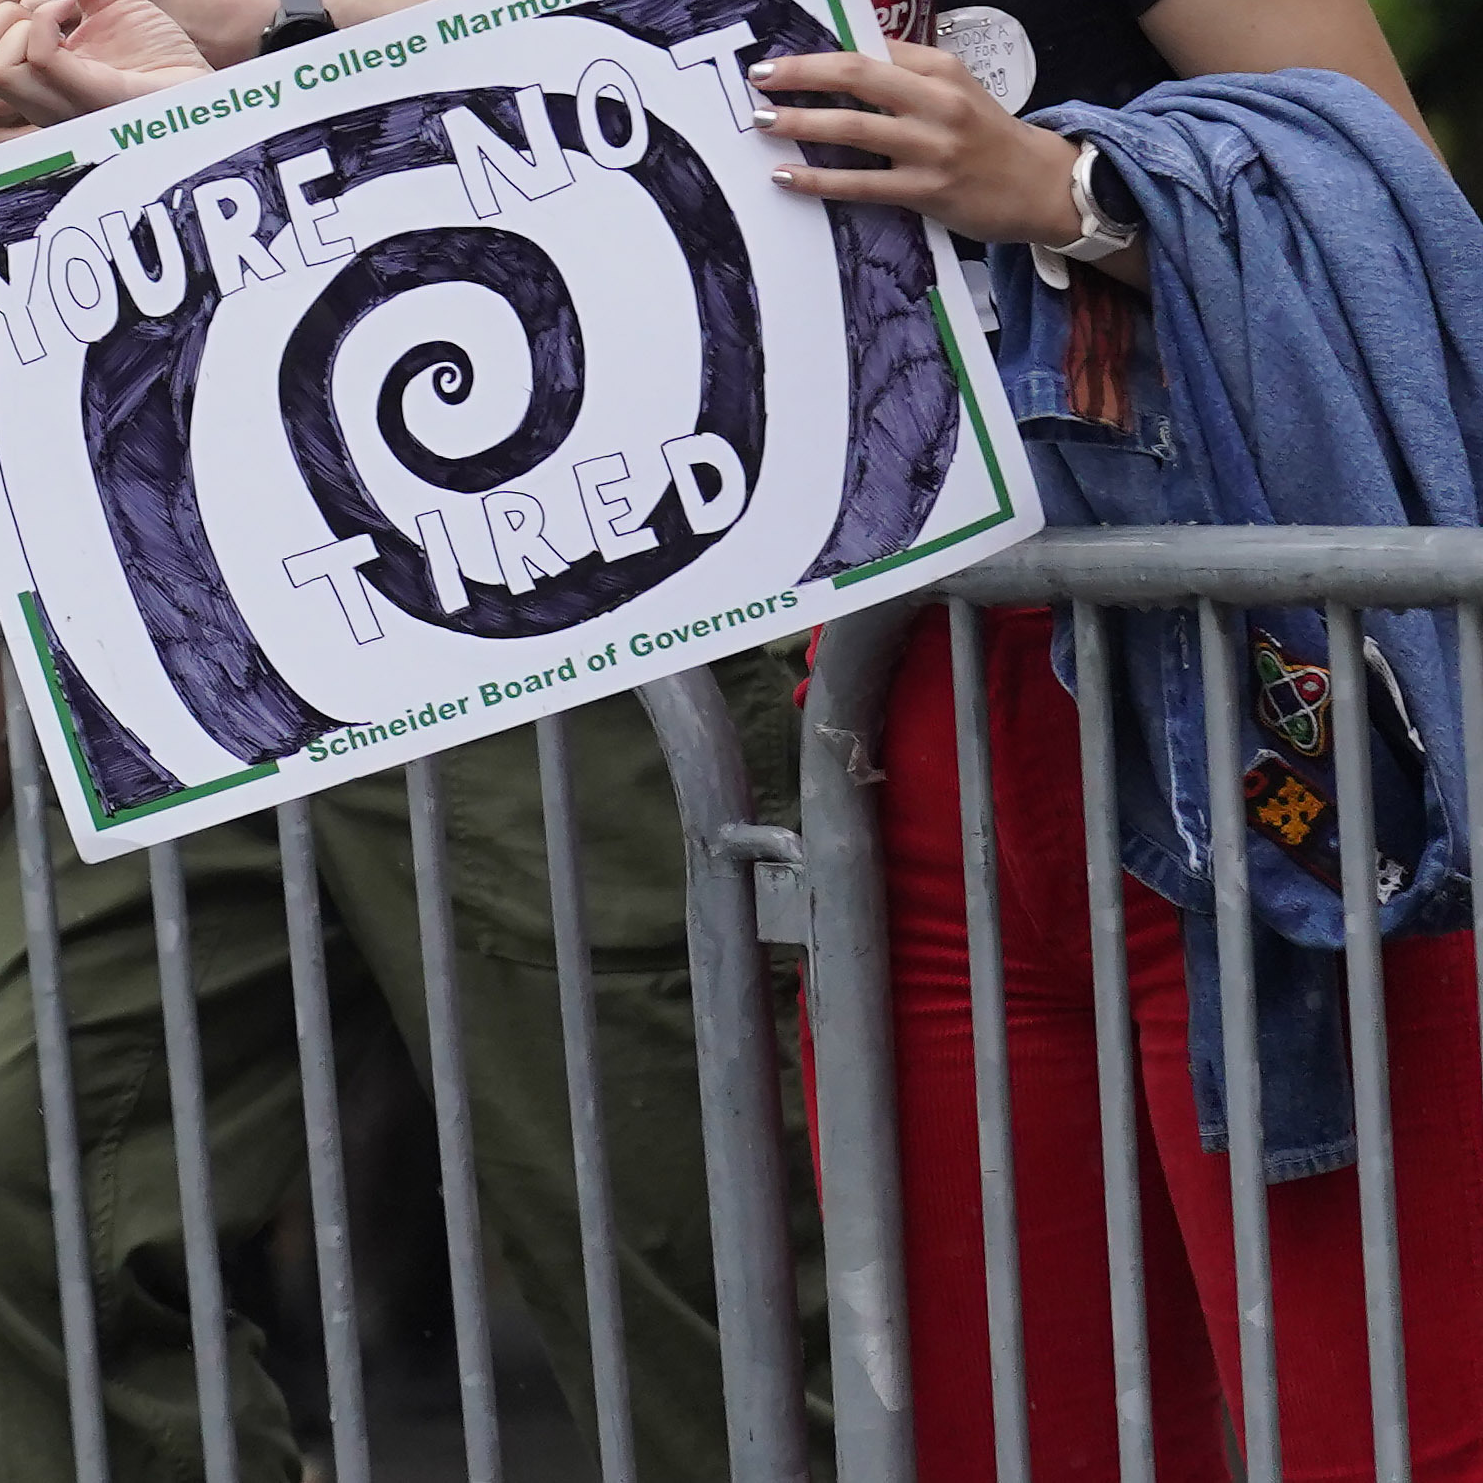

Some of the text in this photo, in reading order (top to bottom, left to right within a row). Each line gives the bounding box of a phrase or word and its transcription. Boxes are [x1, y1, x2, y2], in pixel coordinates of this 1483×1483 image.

[110, 79, 283, 151] Wellesley
[293, 34, 429, 91] College
[440, 20, 758, 220] NOT
[282, 432, 748, 645] TIRED
[307, 589, 800, 764] Schneider Board of Governors
